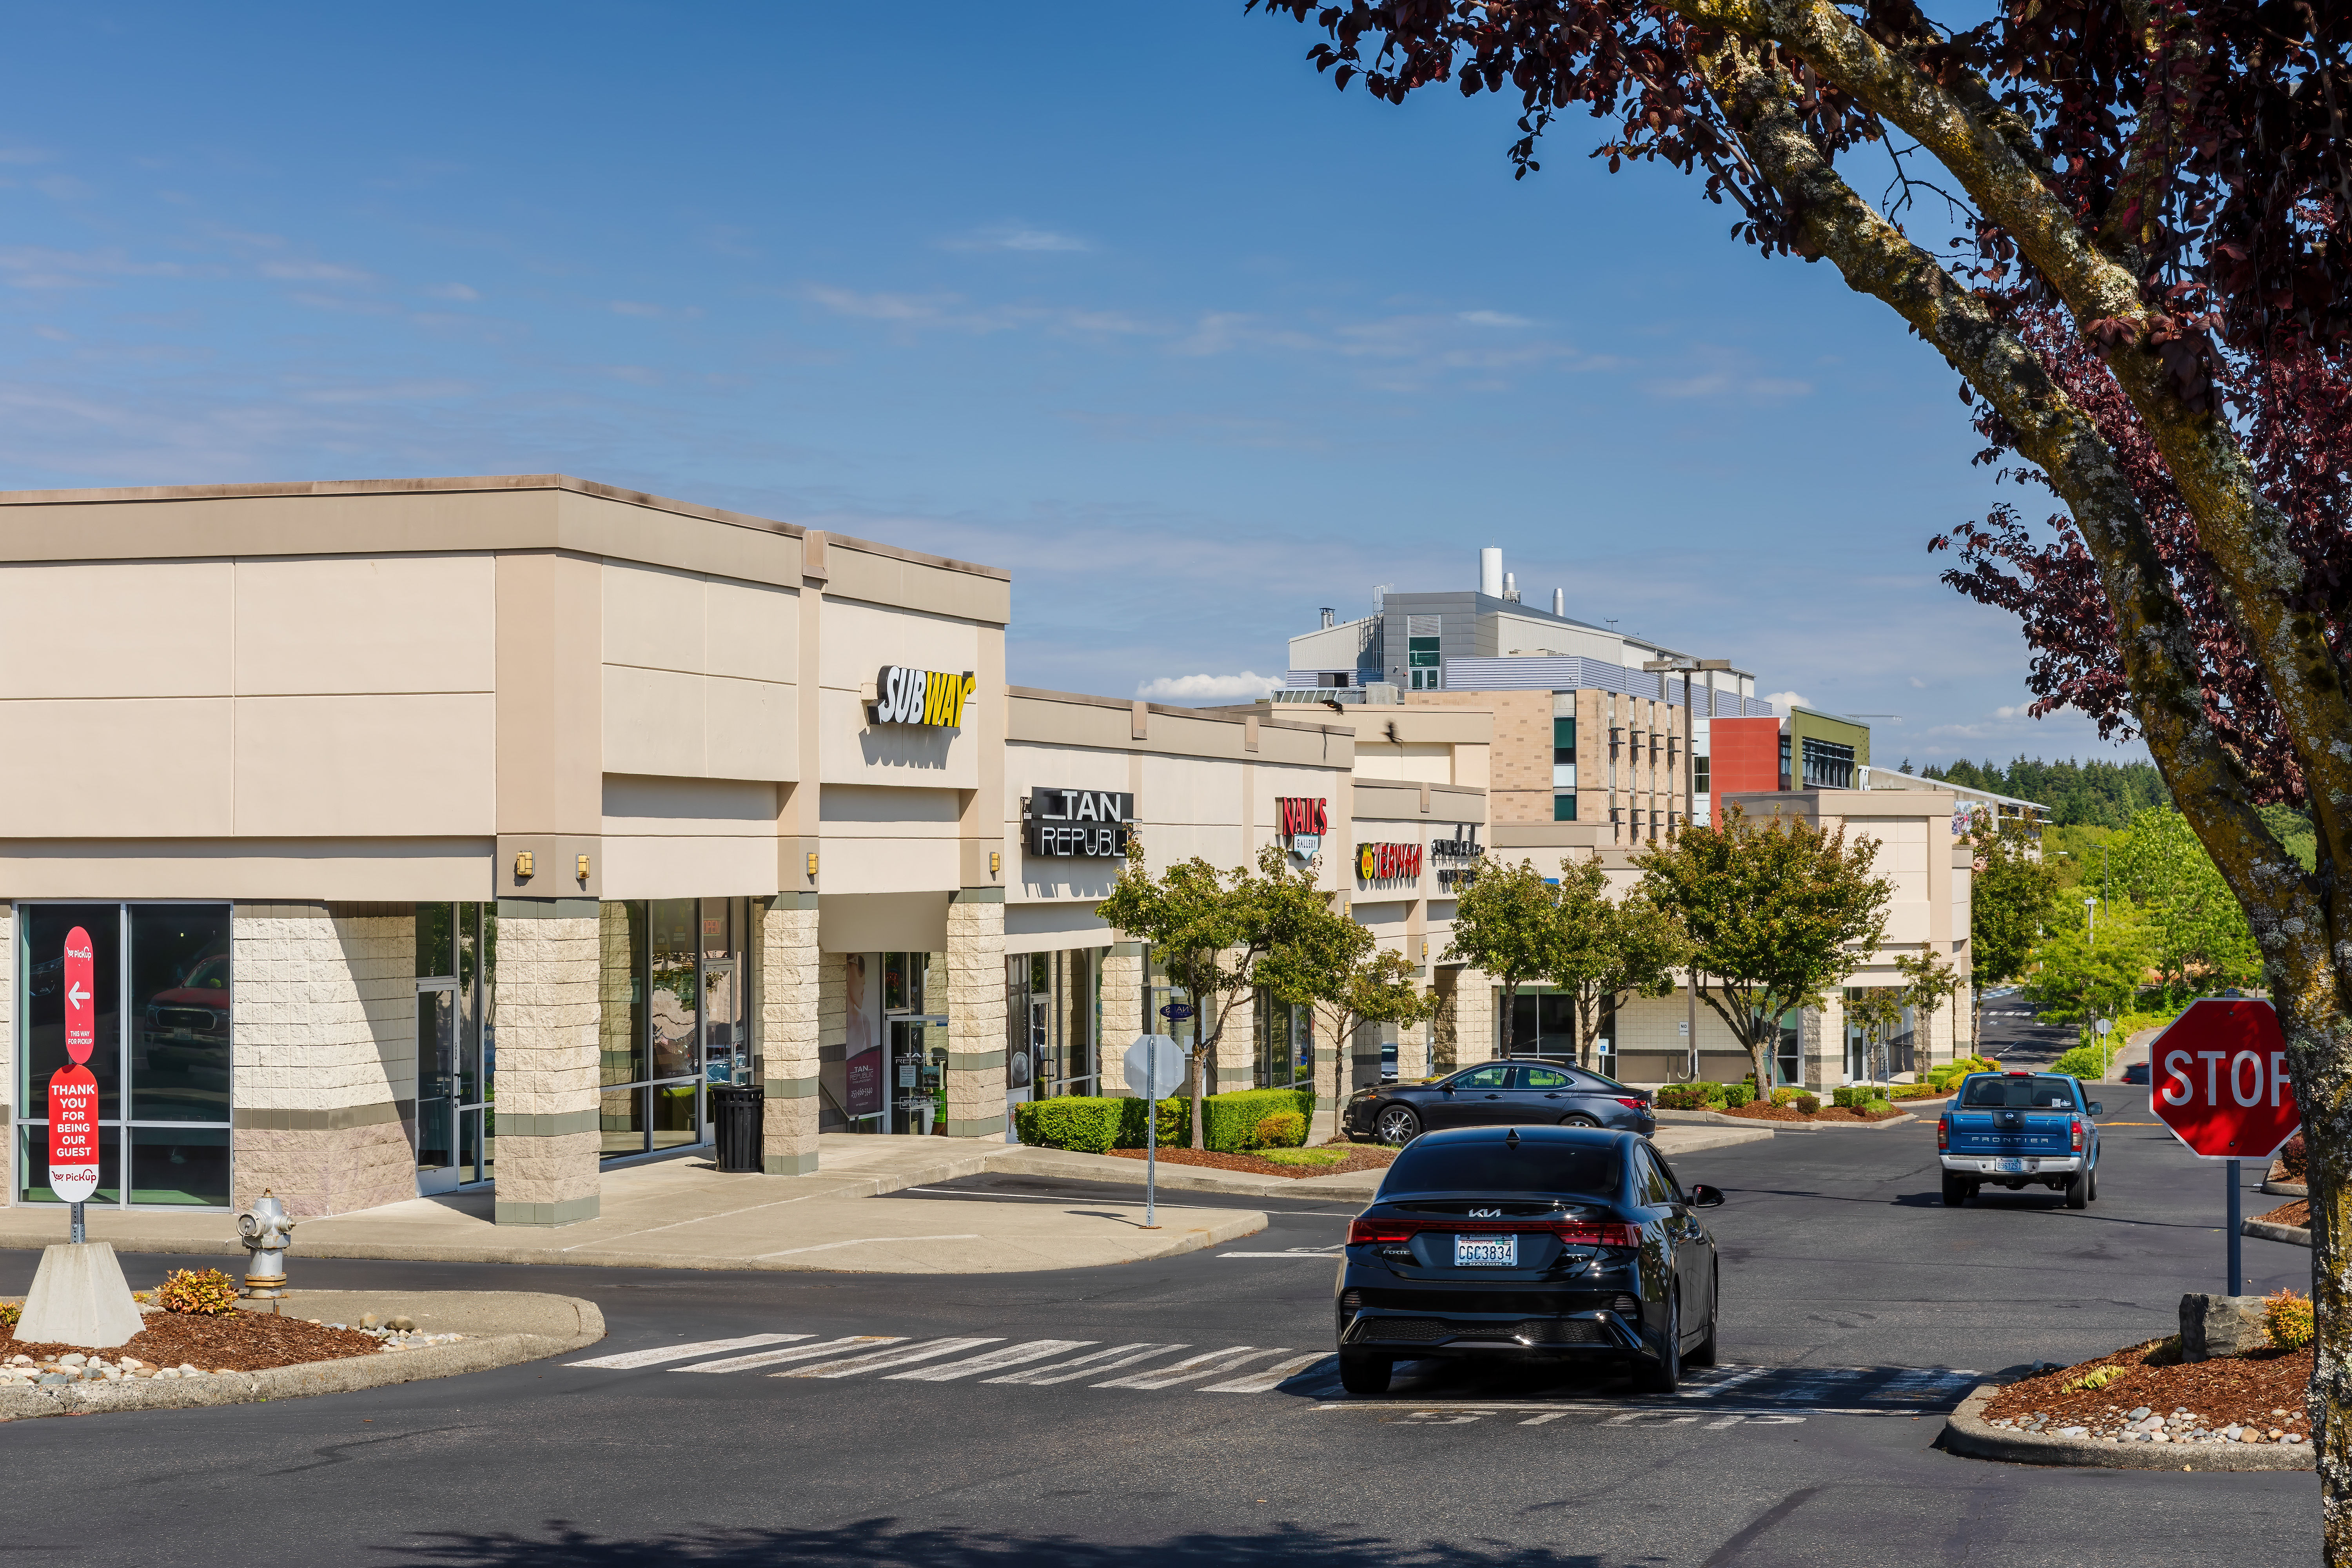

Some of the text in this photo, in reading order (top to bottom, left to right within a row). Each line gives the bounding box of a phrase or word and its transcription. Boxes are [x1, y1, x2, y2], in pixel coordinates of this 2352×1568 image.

[878, 666, 976, 728] SUBWAY
[1062, 790, 1120, 822] TAN
[1283, 797, 1327, 836] NAILS
[1297, 839, 1316, 848] GALLERY
[1363, 855, 1372, 868] WOK
[1373, 843, 1422, 878] TERIYAKI
[703, 920, 719, 934] OPEN
[850, 1071, 873, 1081] REPUBLIC
[51, 1084, 94, 1095] THANK
[60, 1098, 86, 1109] YOU
[63, 1112, 85, 1121] FOR
[58, 1123, 90, 1132] BEING
[62, 1136, 85, 1145] OUR
[57, 1147, 91, 1157] GUEST
[1459, 1246, 1512, 1259] CGC3834
